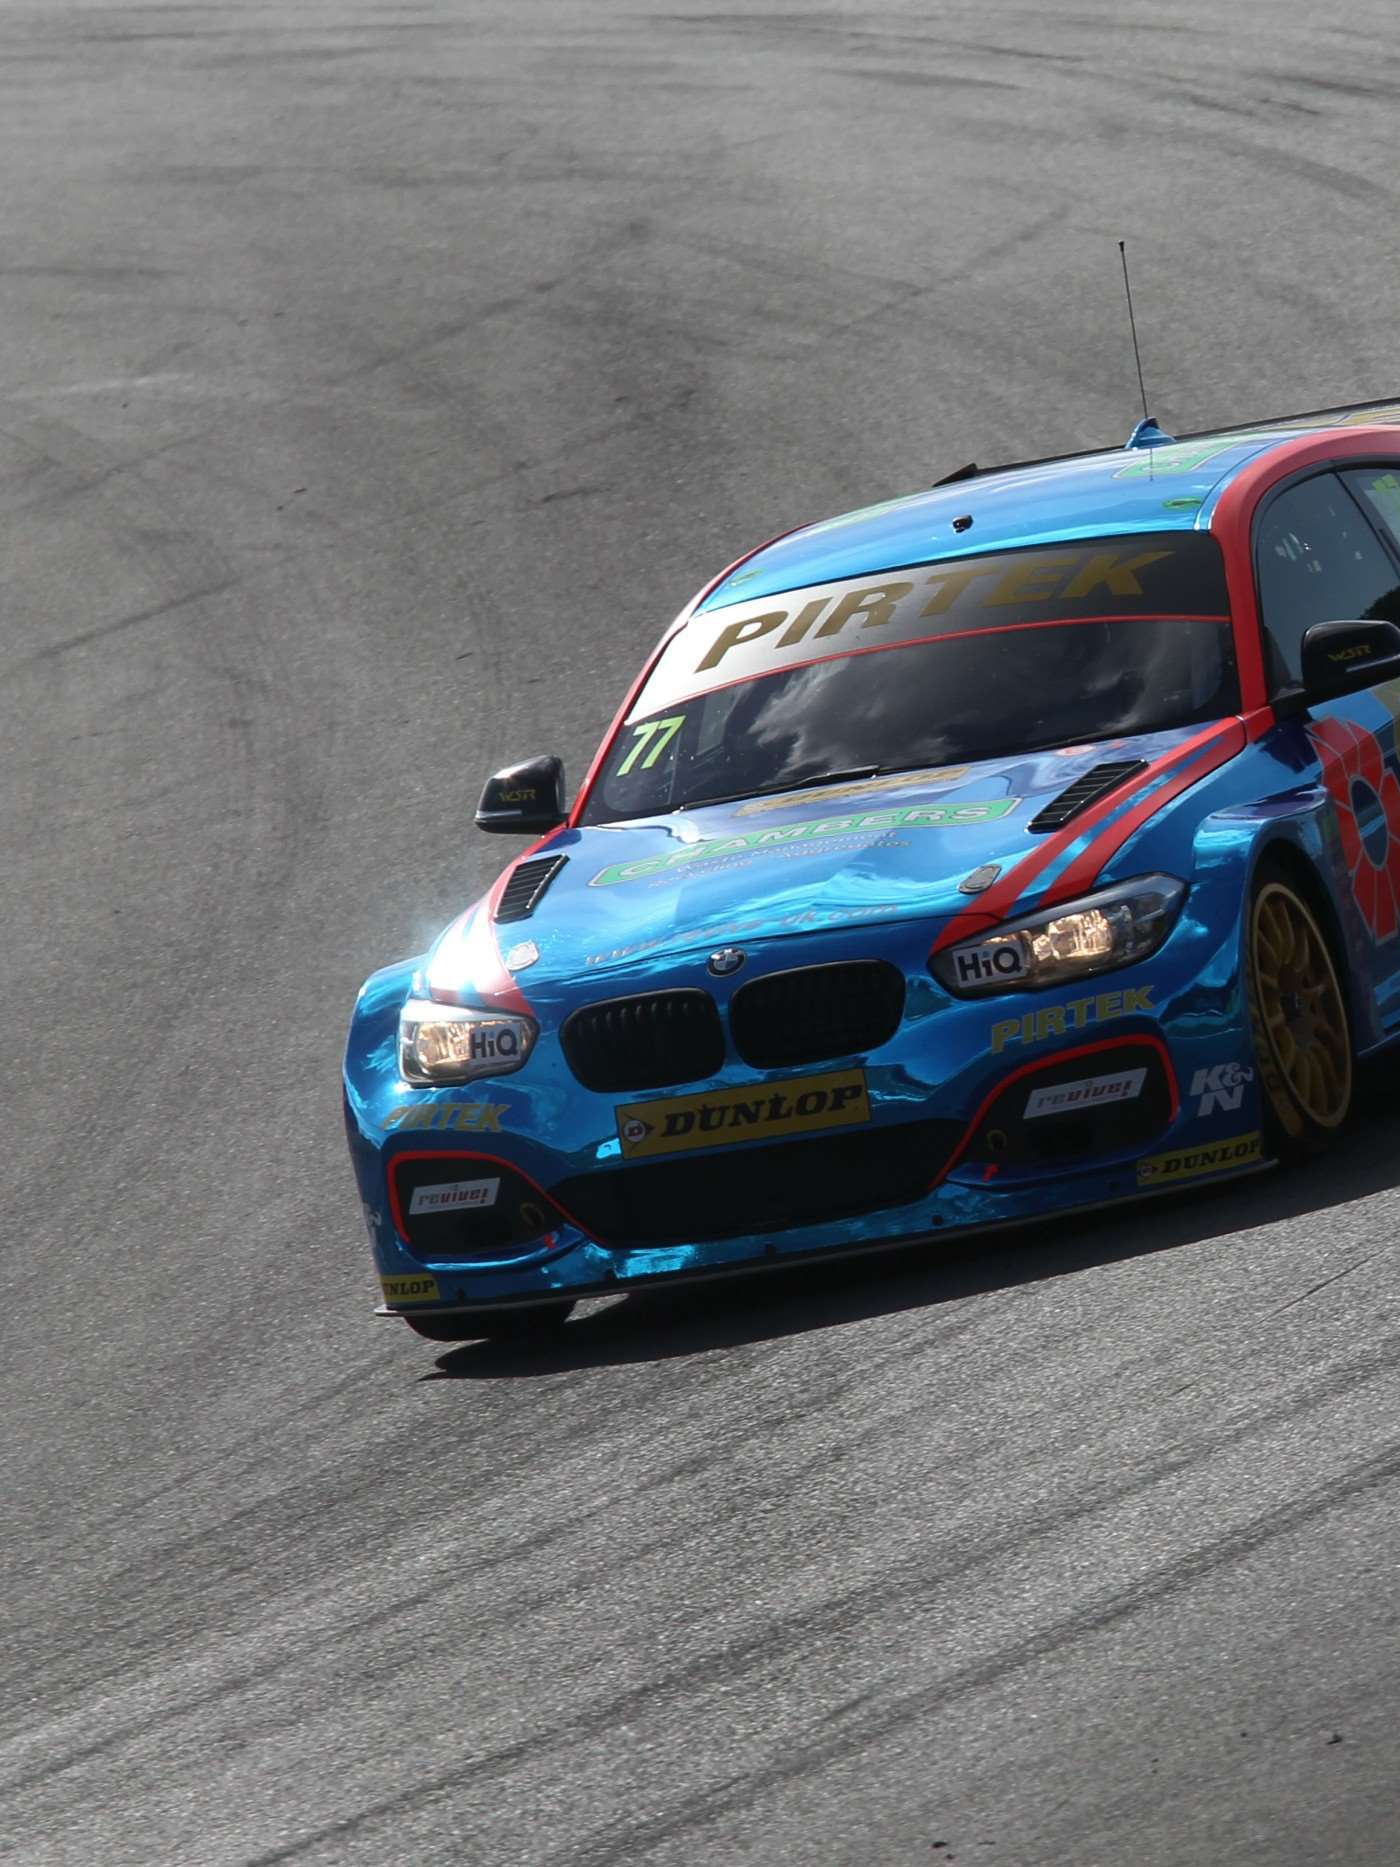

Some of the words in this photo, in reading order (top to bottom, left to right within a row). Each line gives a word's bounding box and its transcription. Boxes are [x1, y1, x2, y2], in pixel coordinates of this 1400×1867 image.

[695, 551, 1174, 674] PIRTEK
[616, 715, 686, 777] 77
[958, 947, 1022, 981] HiQ
[471, 1029, 518, 1059] HiQ
[991, 985, 1155, 1054] PIRTEK
[661, 1085, 862, 1136] DUNLOP
[1162, 1139, 1261, 1174] DUNLOP
